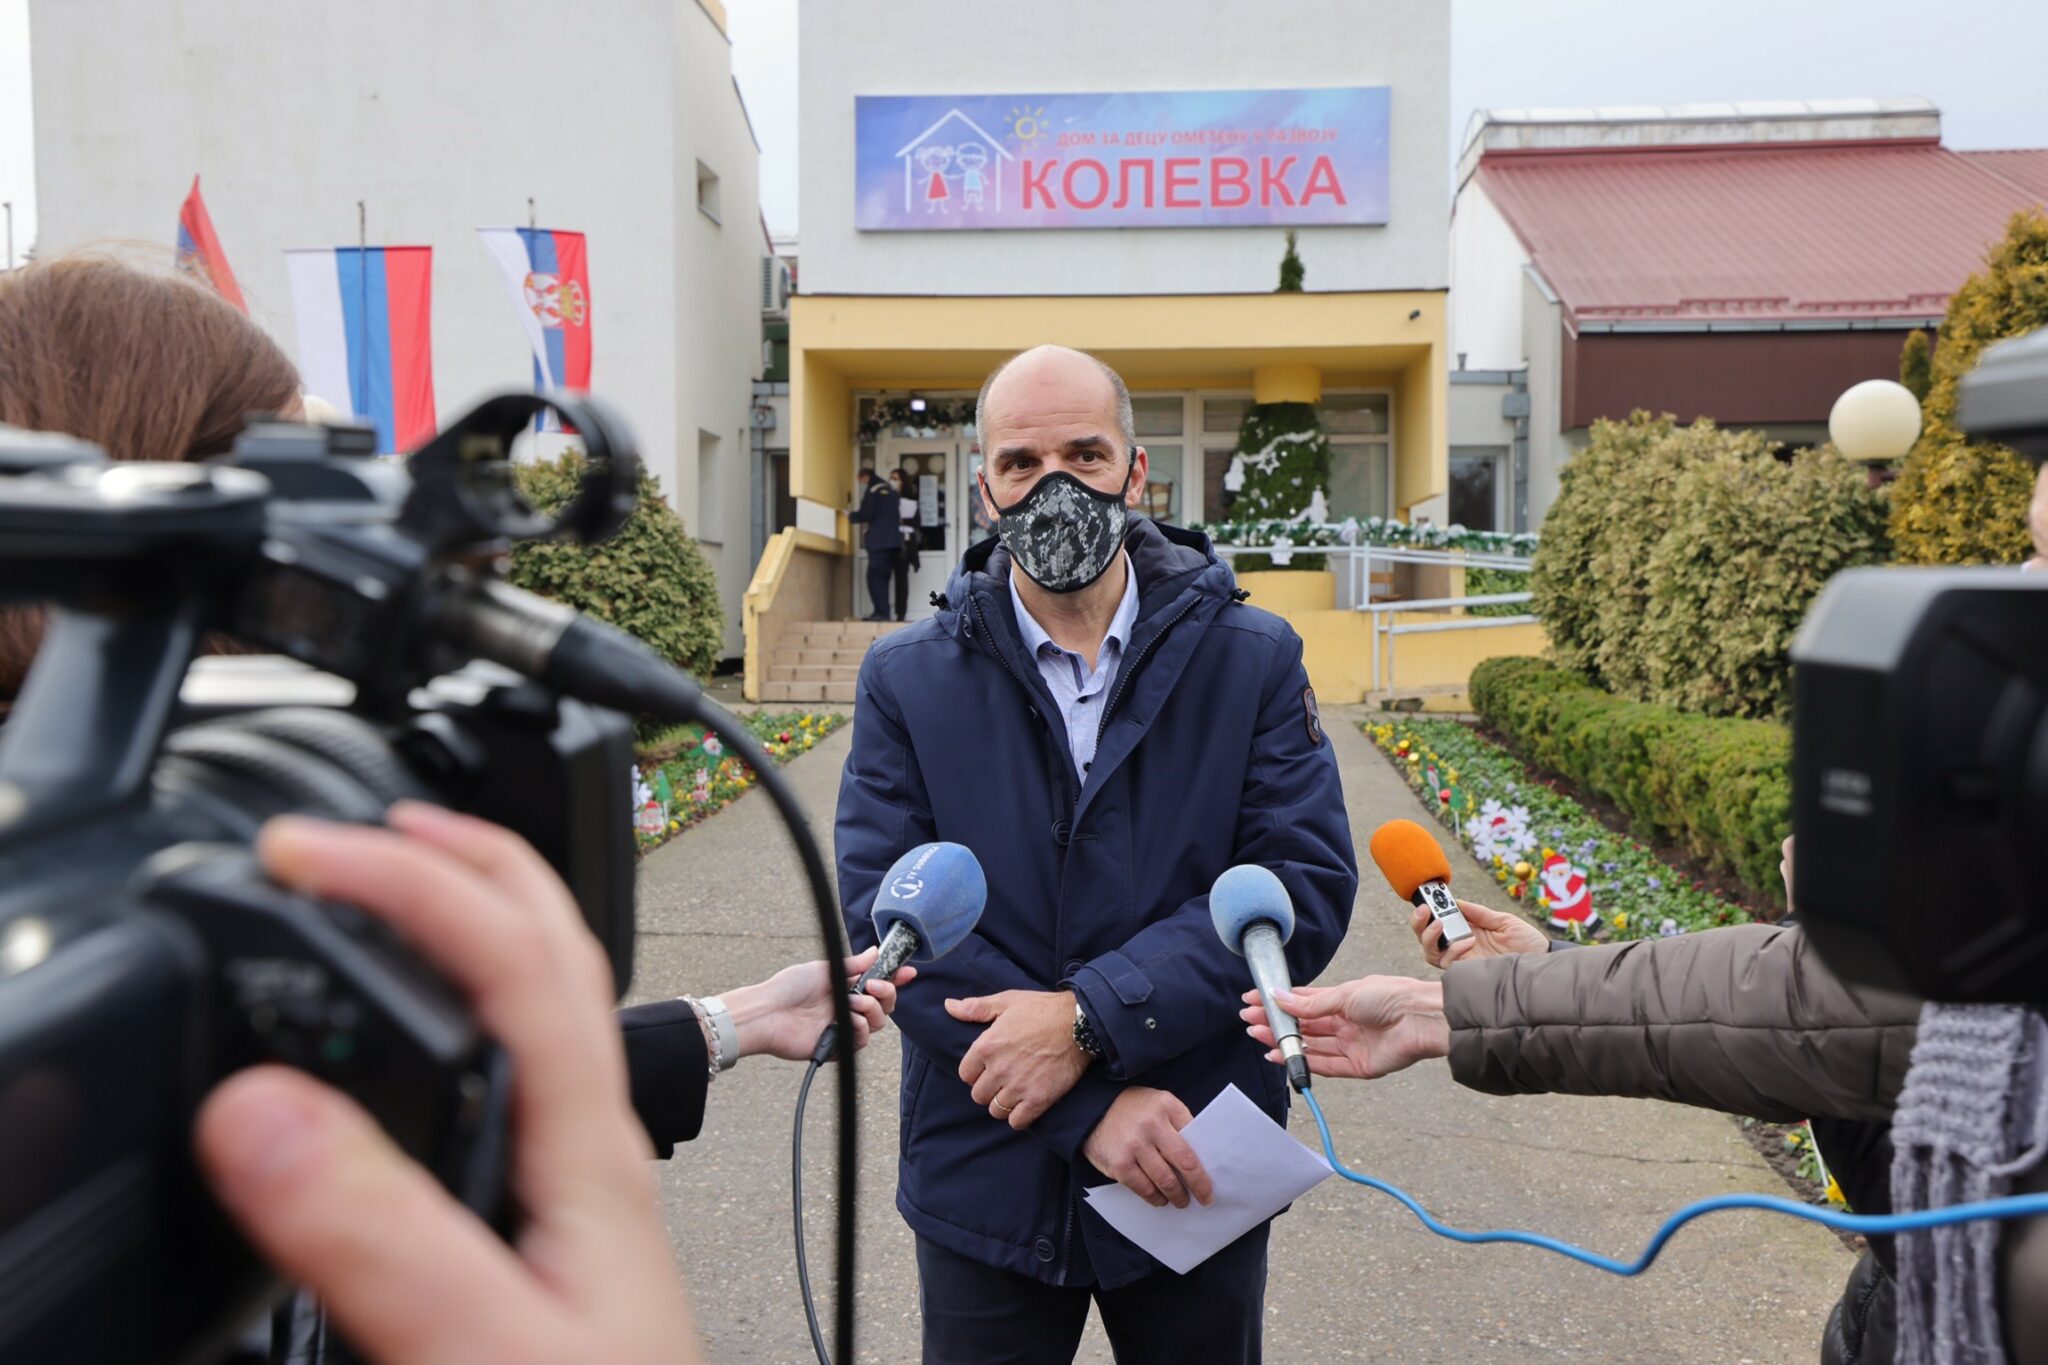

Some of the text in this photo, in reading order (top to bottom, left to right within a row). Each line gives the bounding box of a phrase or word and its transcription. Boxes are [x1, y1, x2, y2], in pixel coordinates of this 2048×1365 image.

[1057, 131, 1096, 147] ДОМ
[1102, 131, 1120, 146] ЗА
[1124, 131, 1168, 148] ДЕЦУ
[1021, 155, 1347, 210] КОЛЕВКА
